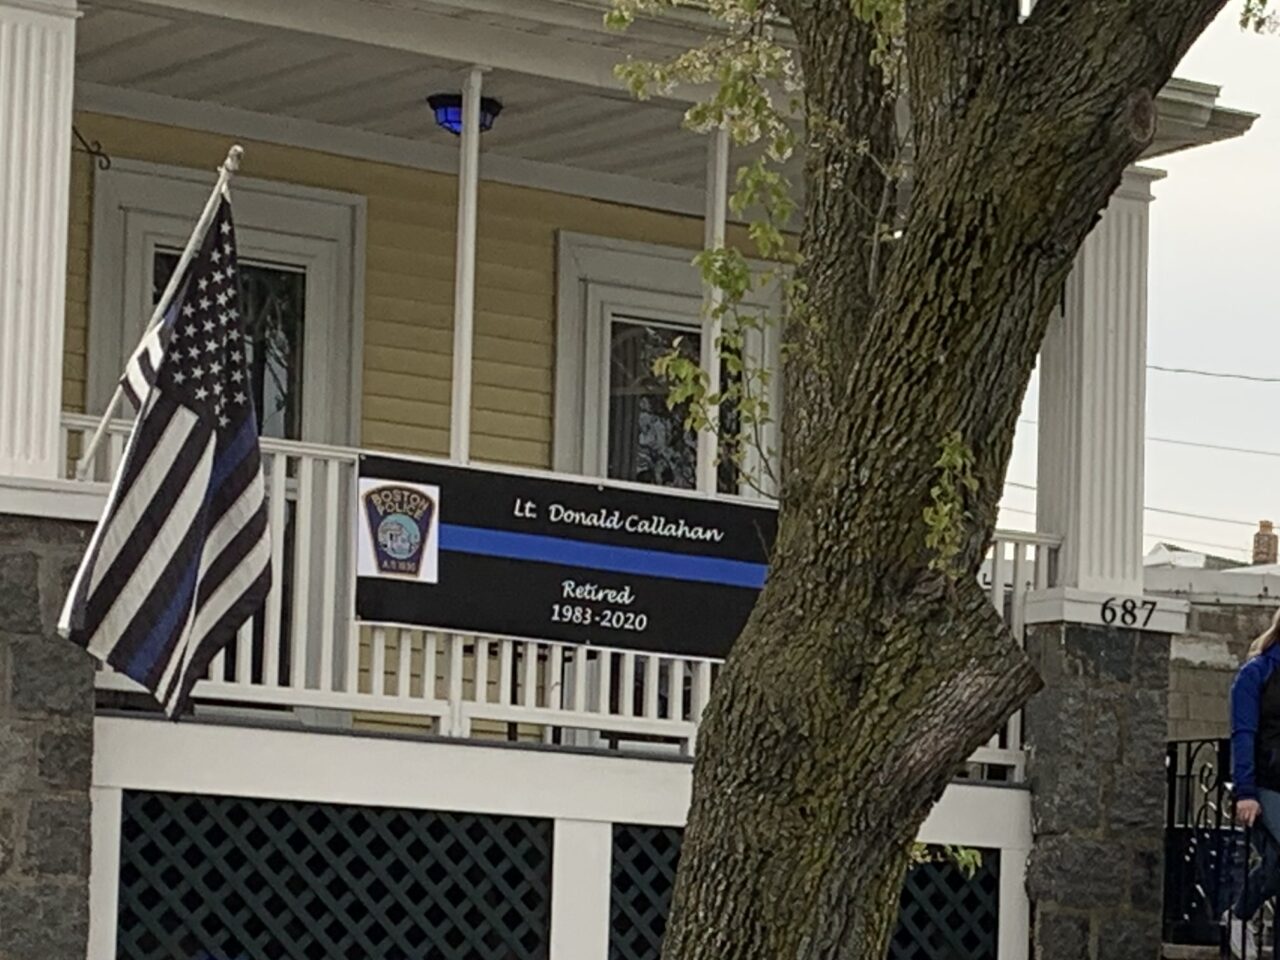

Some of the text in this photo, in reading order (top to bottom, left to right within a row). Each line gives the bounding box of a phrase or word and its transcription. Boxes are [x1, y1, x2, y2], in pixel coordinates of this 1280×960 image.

[371, 489, 429, 511] BOSTON
[377, 501, 423, 520] POLICE
[549, 503, 624, 531] Donald
[624, 514, 724, 541] Callahan
[561, 579, 636, 606] Retired
[550, 603, 648, 632] 1983-2020
[1101, 597, 1157, 628] 687
